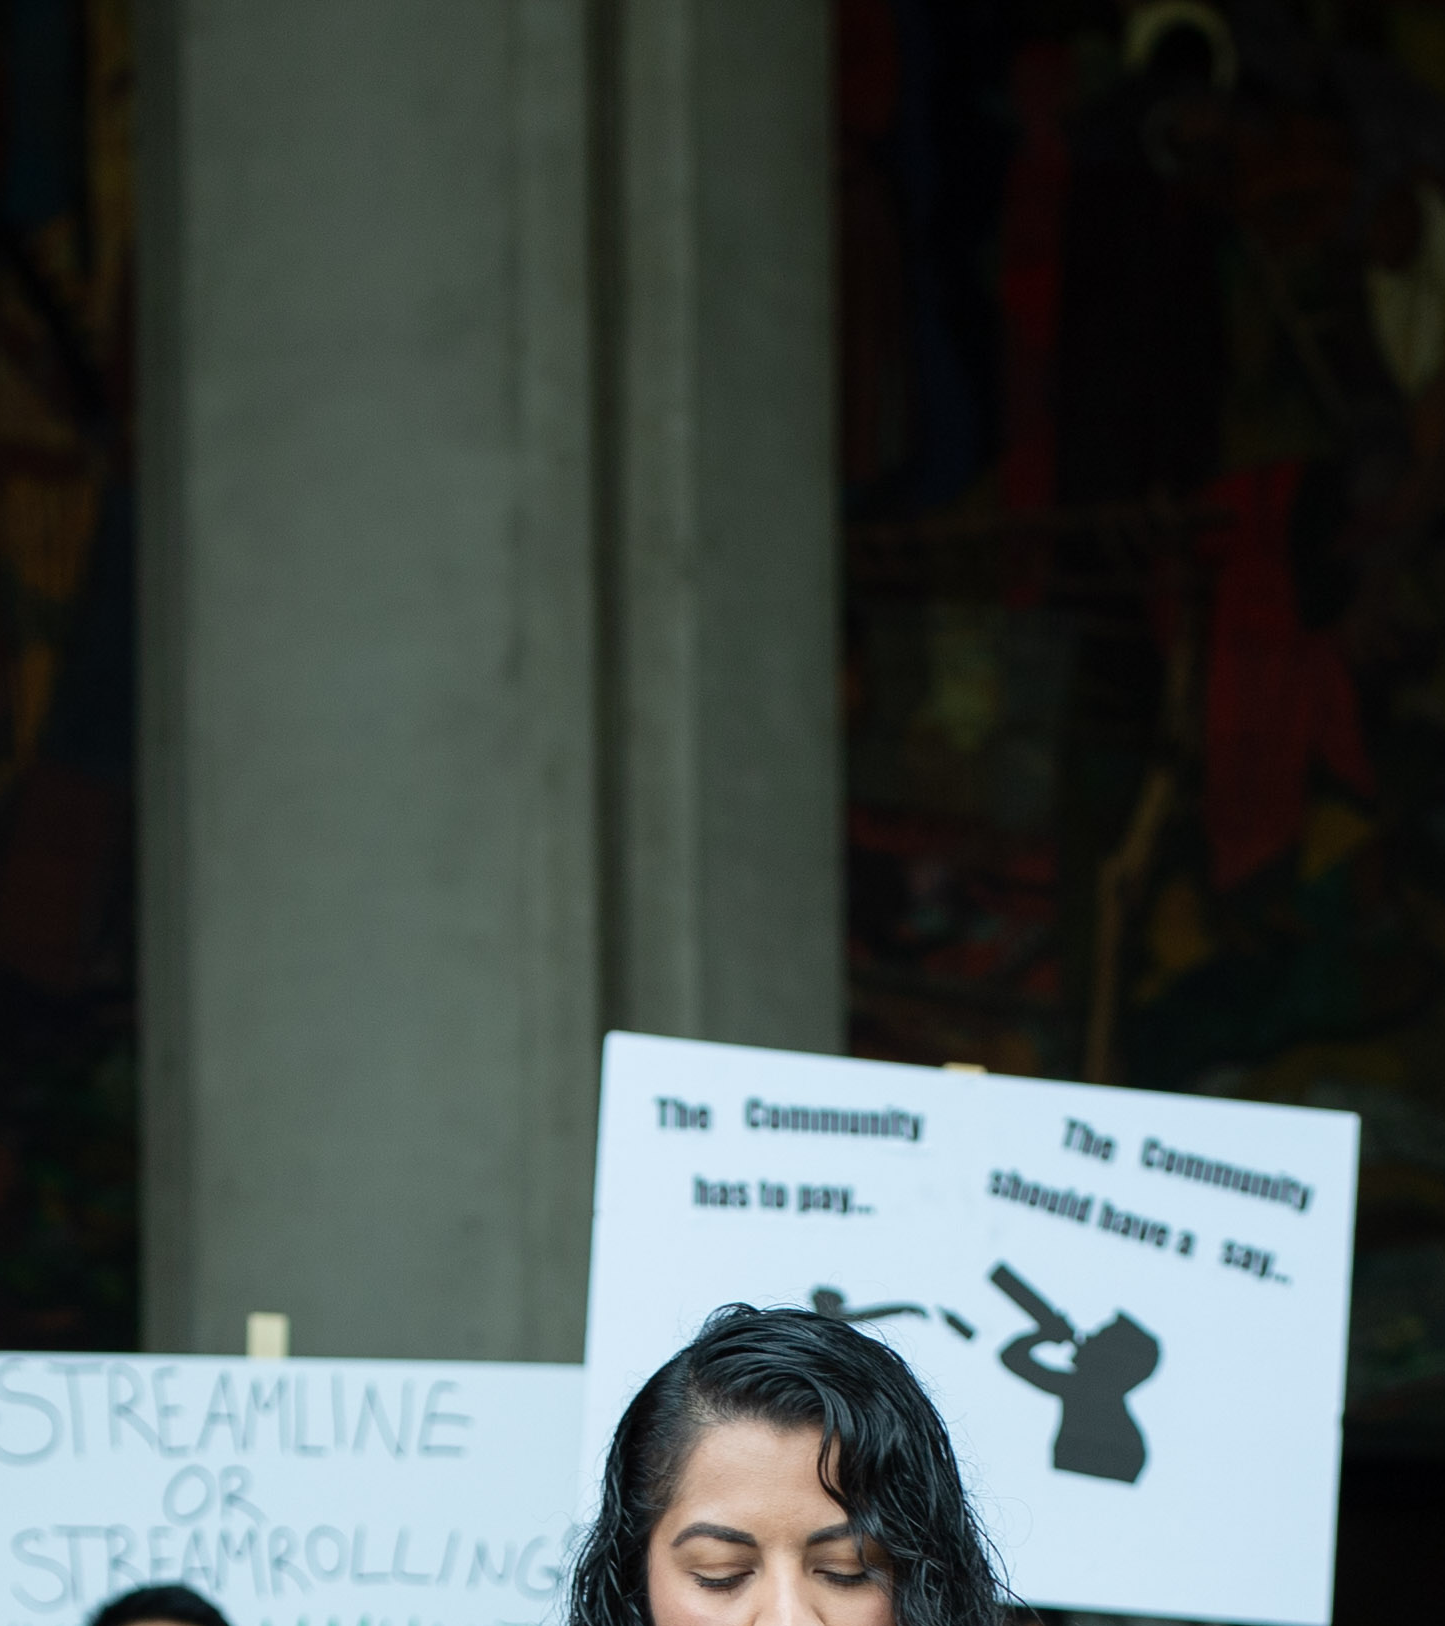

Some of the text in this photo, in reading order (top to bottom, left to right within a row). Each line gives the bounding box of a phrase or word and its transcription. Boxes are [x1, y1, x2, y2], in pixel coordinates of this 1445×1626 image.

[655, 1097, 926, 1145] The Community
[693, 1175, 750, 1209] has
[758, 1178, 788, 1209] to
[1063, 1117, 1314, 1215] The Community
[988, 1168, 1095, 1232] should
[1098, 1200, 1171, 1252] have
[1175, 1229, 1196, 1258] a
[161, 1462, 269, 1528] OR
[9, 1522, 579, 1614] STREAMROLLING
